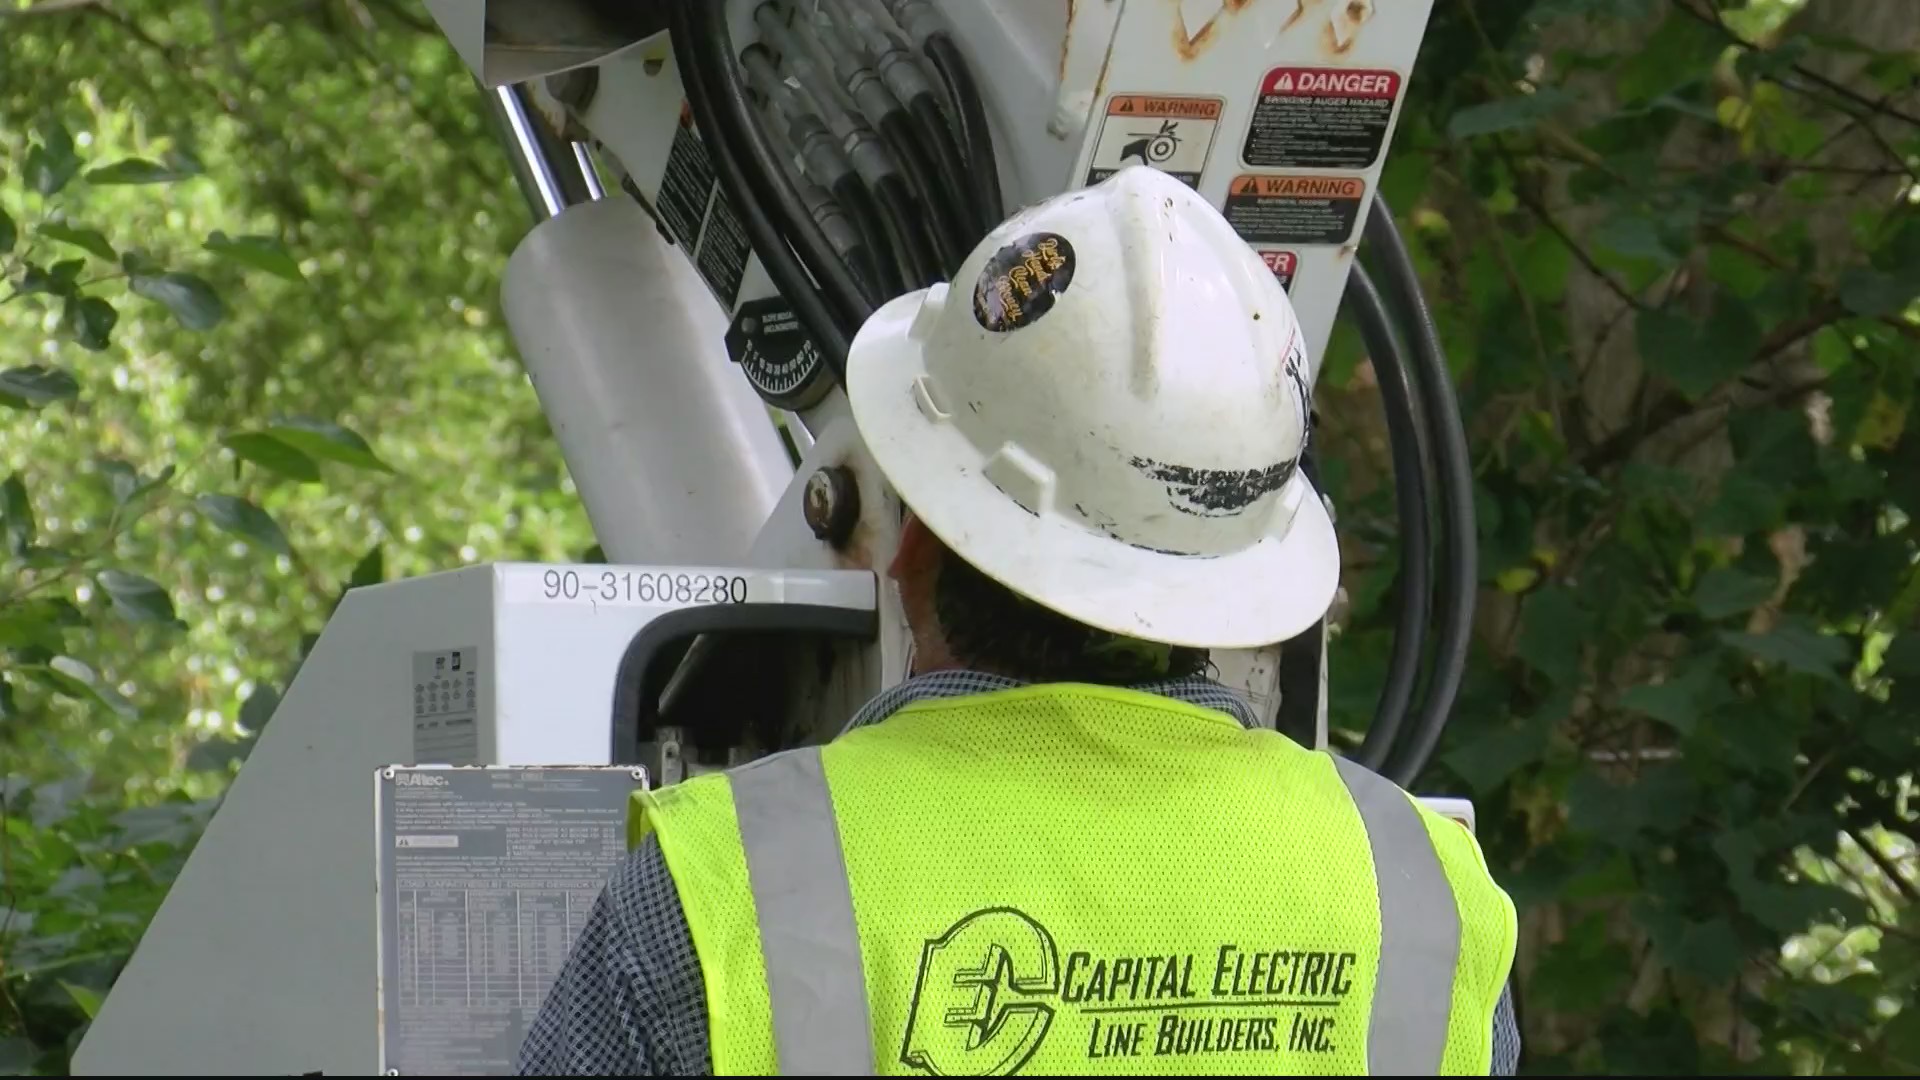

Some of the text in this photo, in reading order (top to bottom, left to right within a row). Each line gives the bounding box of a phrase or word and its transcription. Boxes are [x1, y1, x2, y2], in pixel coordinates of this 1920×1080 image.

[1297, 72, 1391, 93] DANGER
[1143, 99, 1217, 116] WARNING
[1265, 179, 1355, 195] WARNING
[544, 569, 747, 604] 90-31608280
